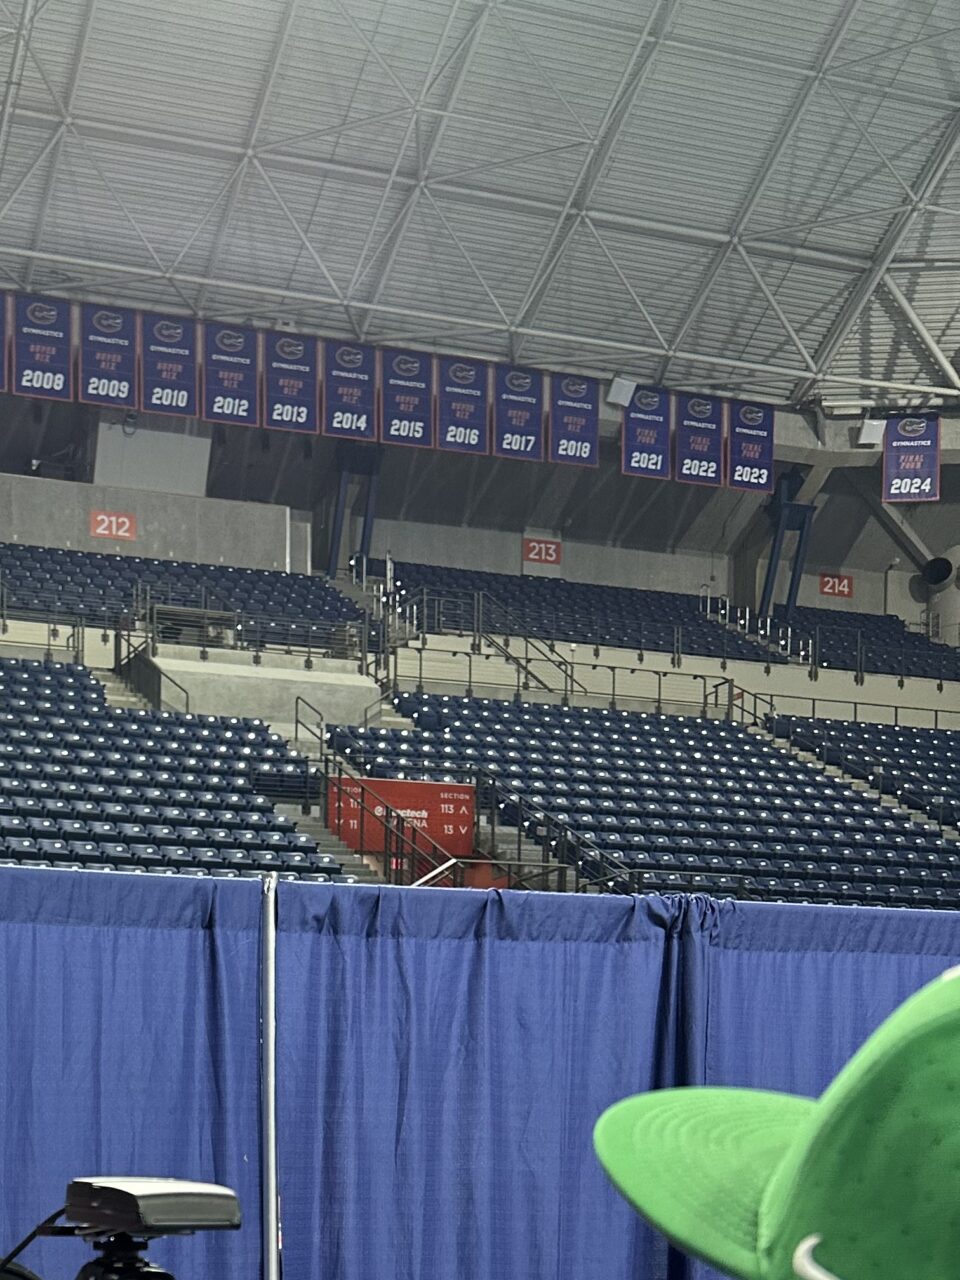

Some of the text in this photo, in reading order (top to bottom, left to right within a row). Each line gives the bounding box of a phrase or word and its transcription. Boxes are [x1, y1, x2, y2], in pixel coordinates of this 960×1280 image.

[21, 369, 65, 391] 2008
[87, 377, 130, 398] 2009
[151, 387, 189, 408] 2010
[213, 396, 249, 417] 2012
[272, 403, 308, 424] 2013
[332, 411, 368, 432] 2014
[390, 419, 425, 439] 2015
[446, 425, 480, 446] 2016
[502, 433, 536, 452] 2017
[558, 439, 591, 458] 2018
[630, 451, 663, 471] 2021
[682, 458, 718, 478] 2022
[733, 465, 769, 485] 2023
[890, 477, 933, 494] 2024
[96, 515, 130, 536] 212
[528, 543, 556, 560] 213
[823, 578, 850, 594] 214
[441, 804, 454, 814] 113
[444, 825, 454, 834] 13
